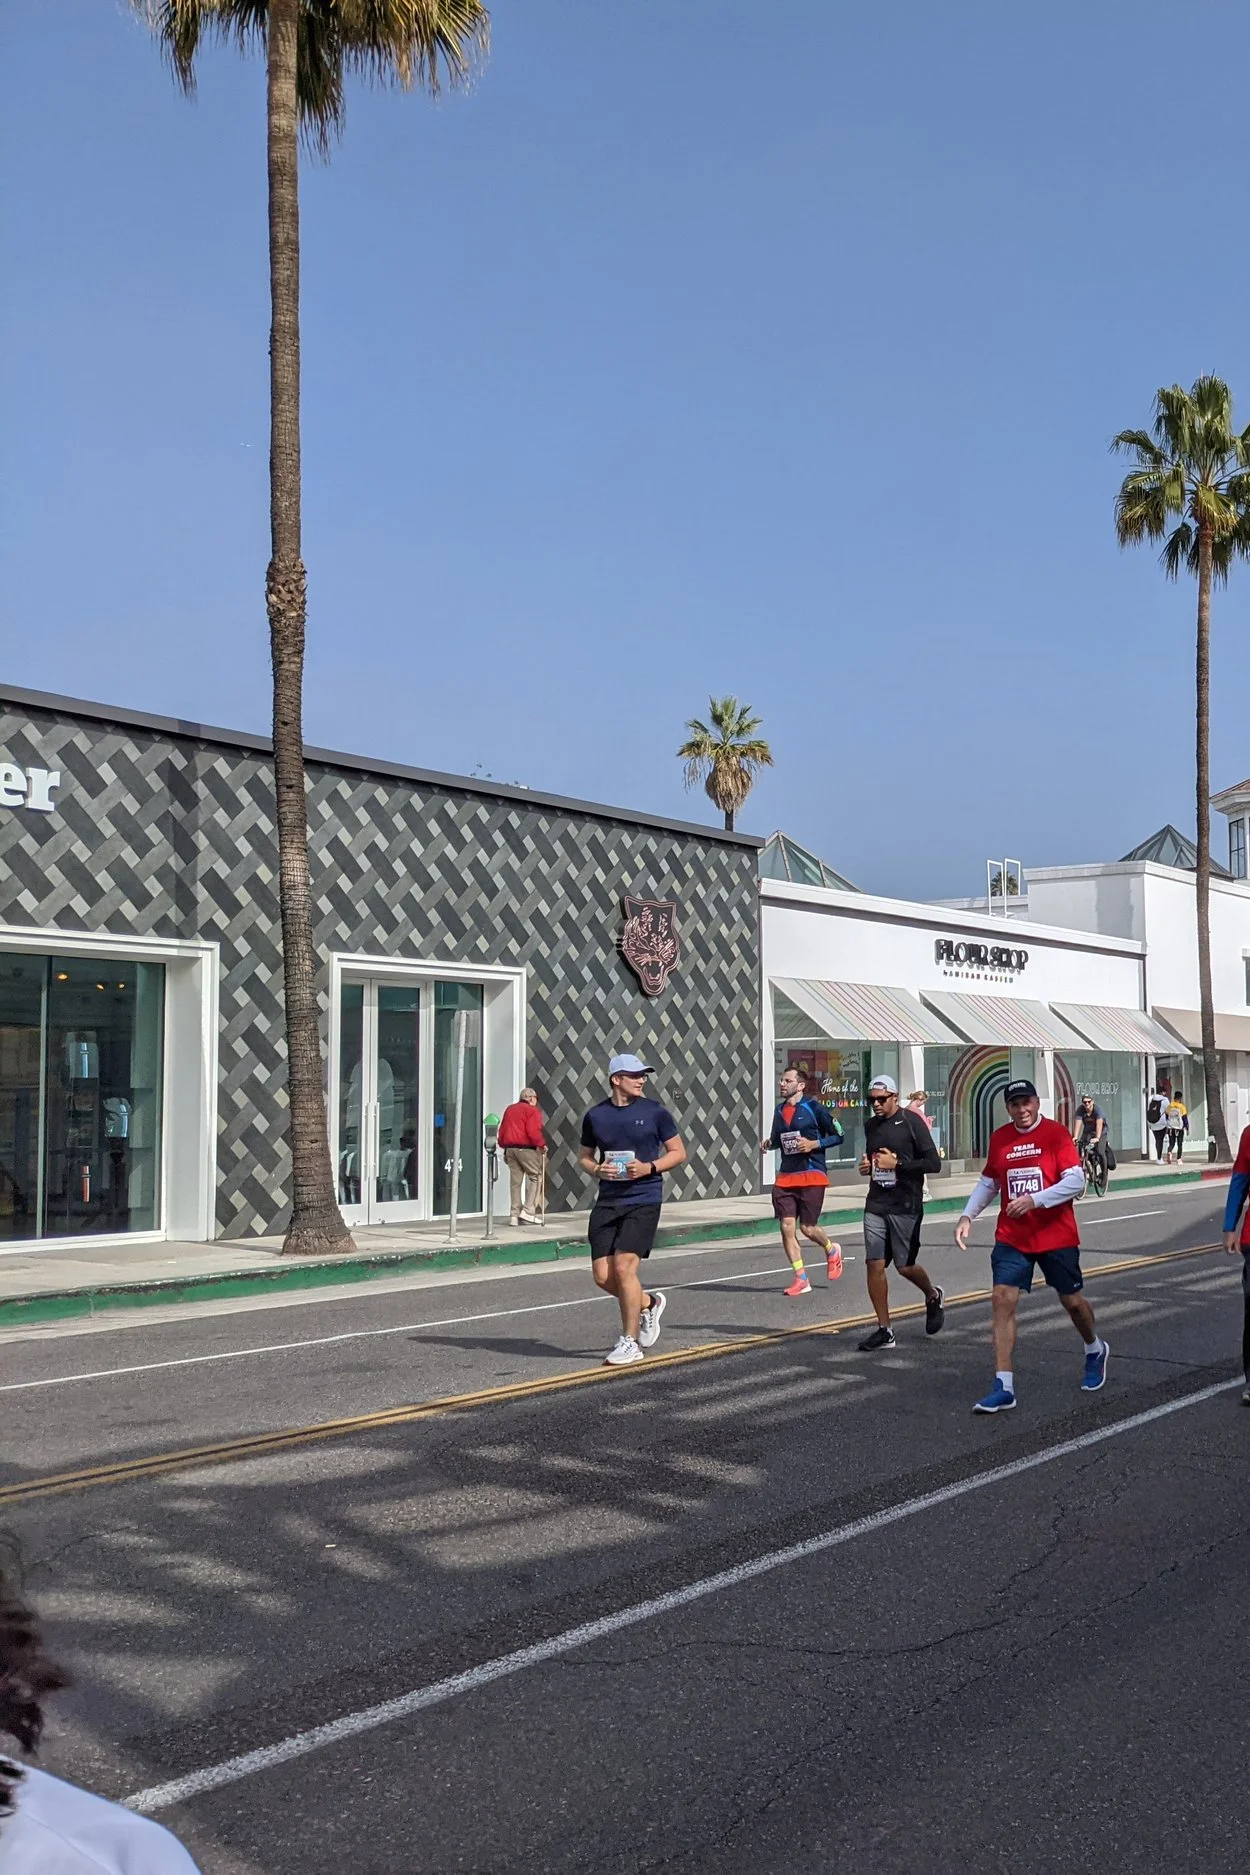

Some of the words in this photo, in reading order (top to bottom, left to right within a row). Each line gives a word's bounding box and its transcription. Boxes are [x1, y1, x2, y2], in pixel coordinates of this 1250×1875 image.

[0, 762, 61, 812] er
[935, 939, 990, 967] FLOUR
[989, 946, 1029, 972] SHOP
[821, 1078, 841, 1095] Home
[841, 1079, 849, 1099] of
[849, 1079, 859, 1093] the
[820, 1099, 849, 1108] LOSION
[1006, 1148, 1041, 1159] CONCERN
[1013, 1143, 1035, 1152] TEAM
[444, 1158, 463, 1173] 44
[1011, 1179, 1039, 1193] 17748
